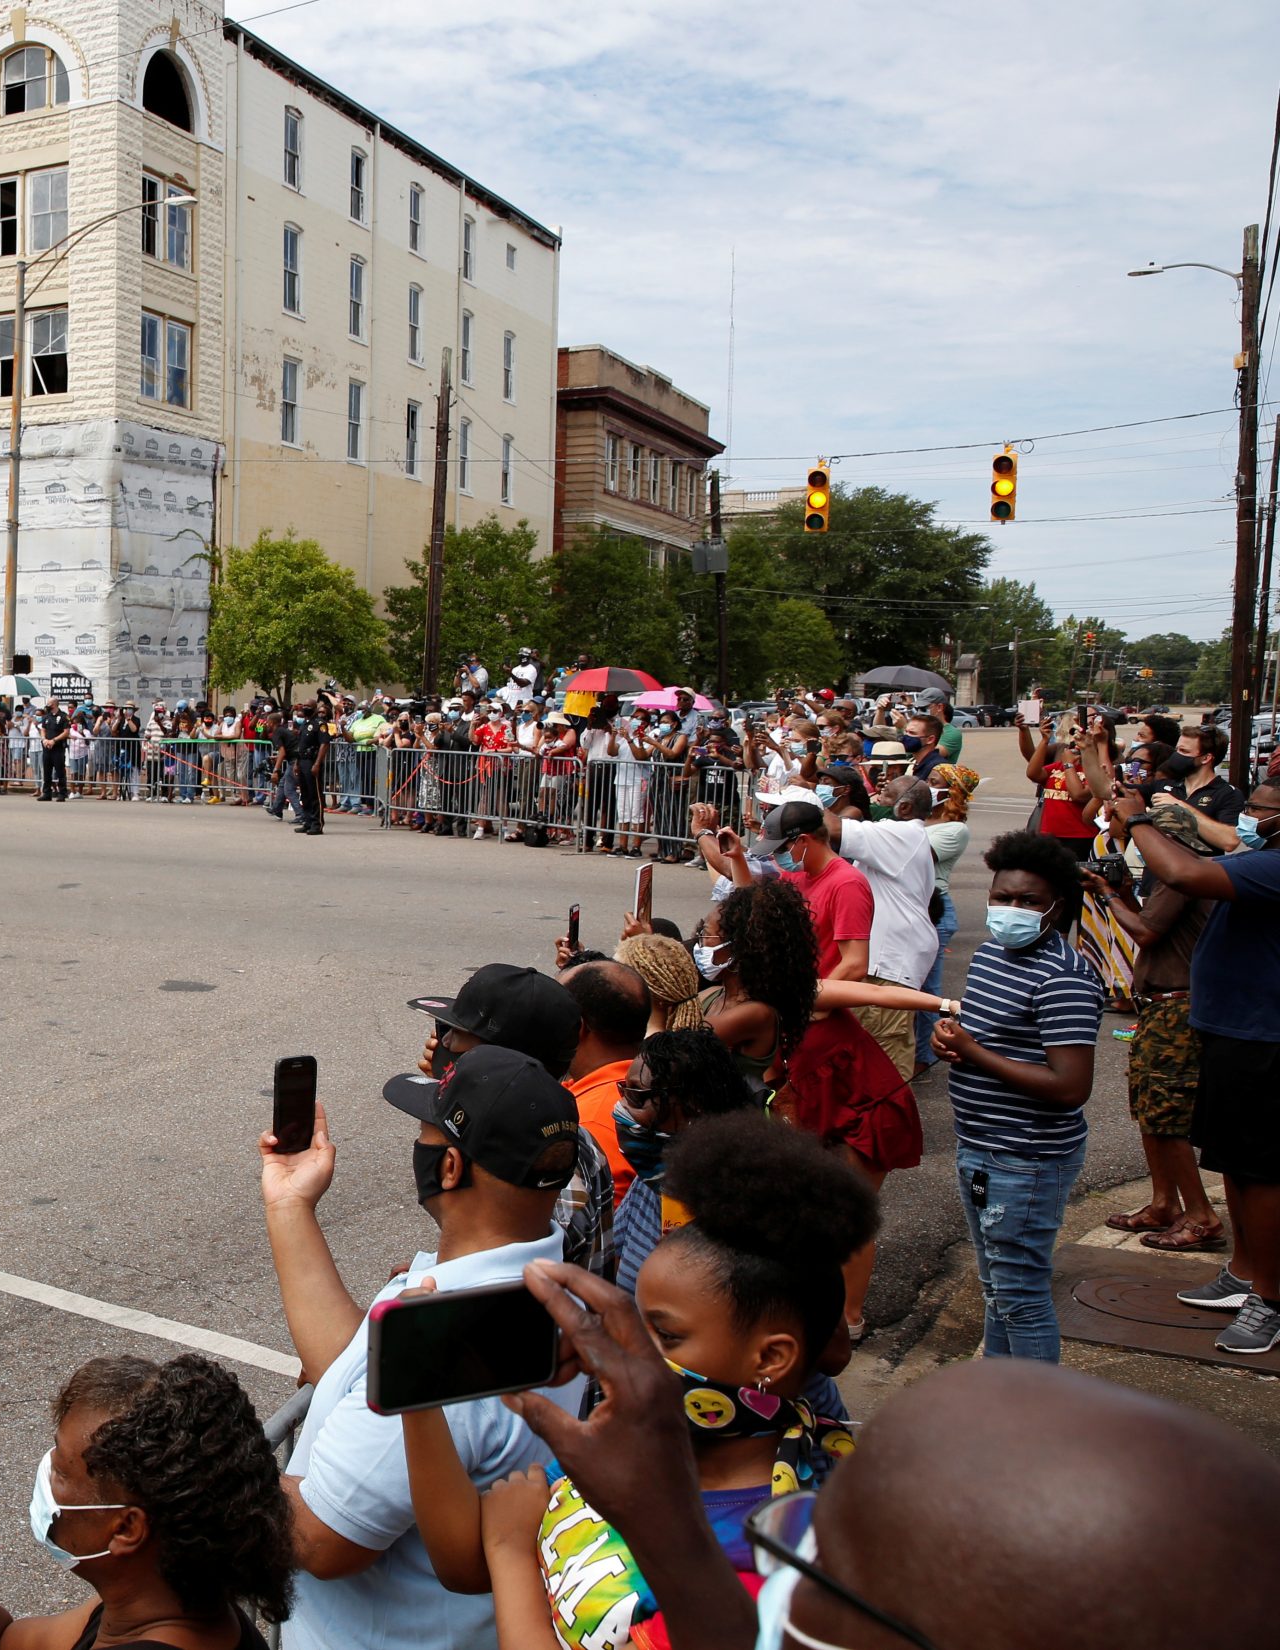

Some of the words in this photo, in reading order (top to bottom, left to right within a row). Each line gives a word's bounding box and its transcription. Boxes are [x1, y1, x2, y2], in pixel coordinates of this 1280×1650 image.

[52, 677, 68, 687] FOR
[70, 677, 90, 688] SALE
[541, 1122, 560, 1138] WON
